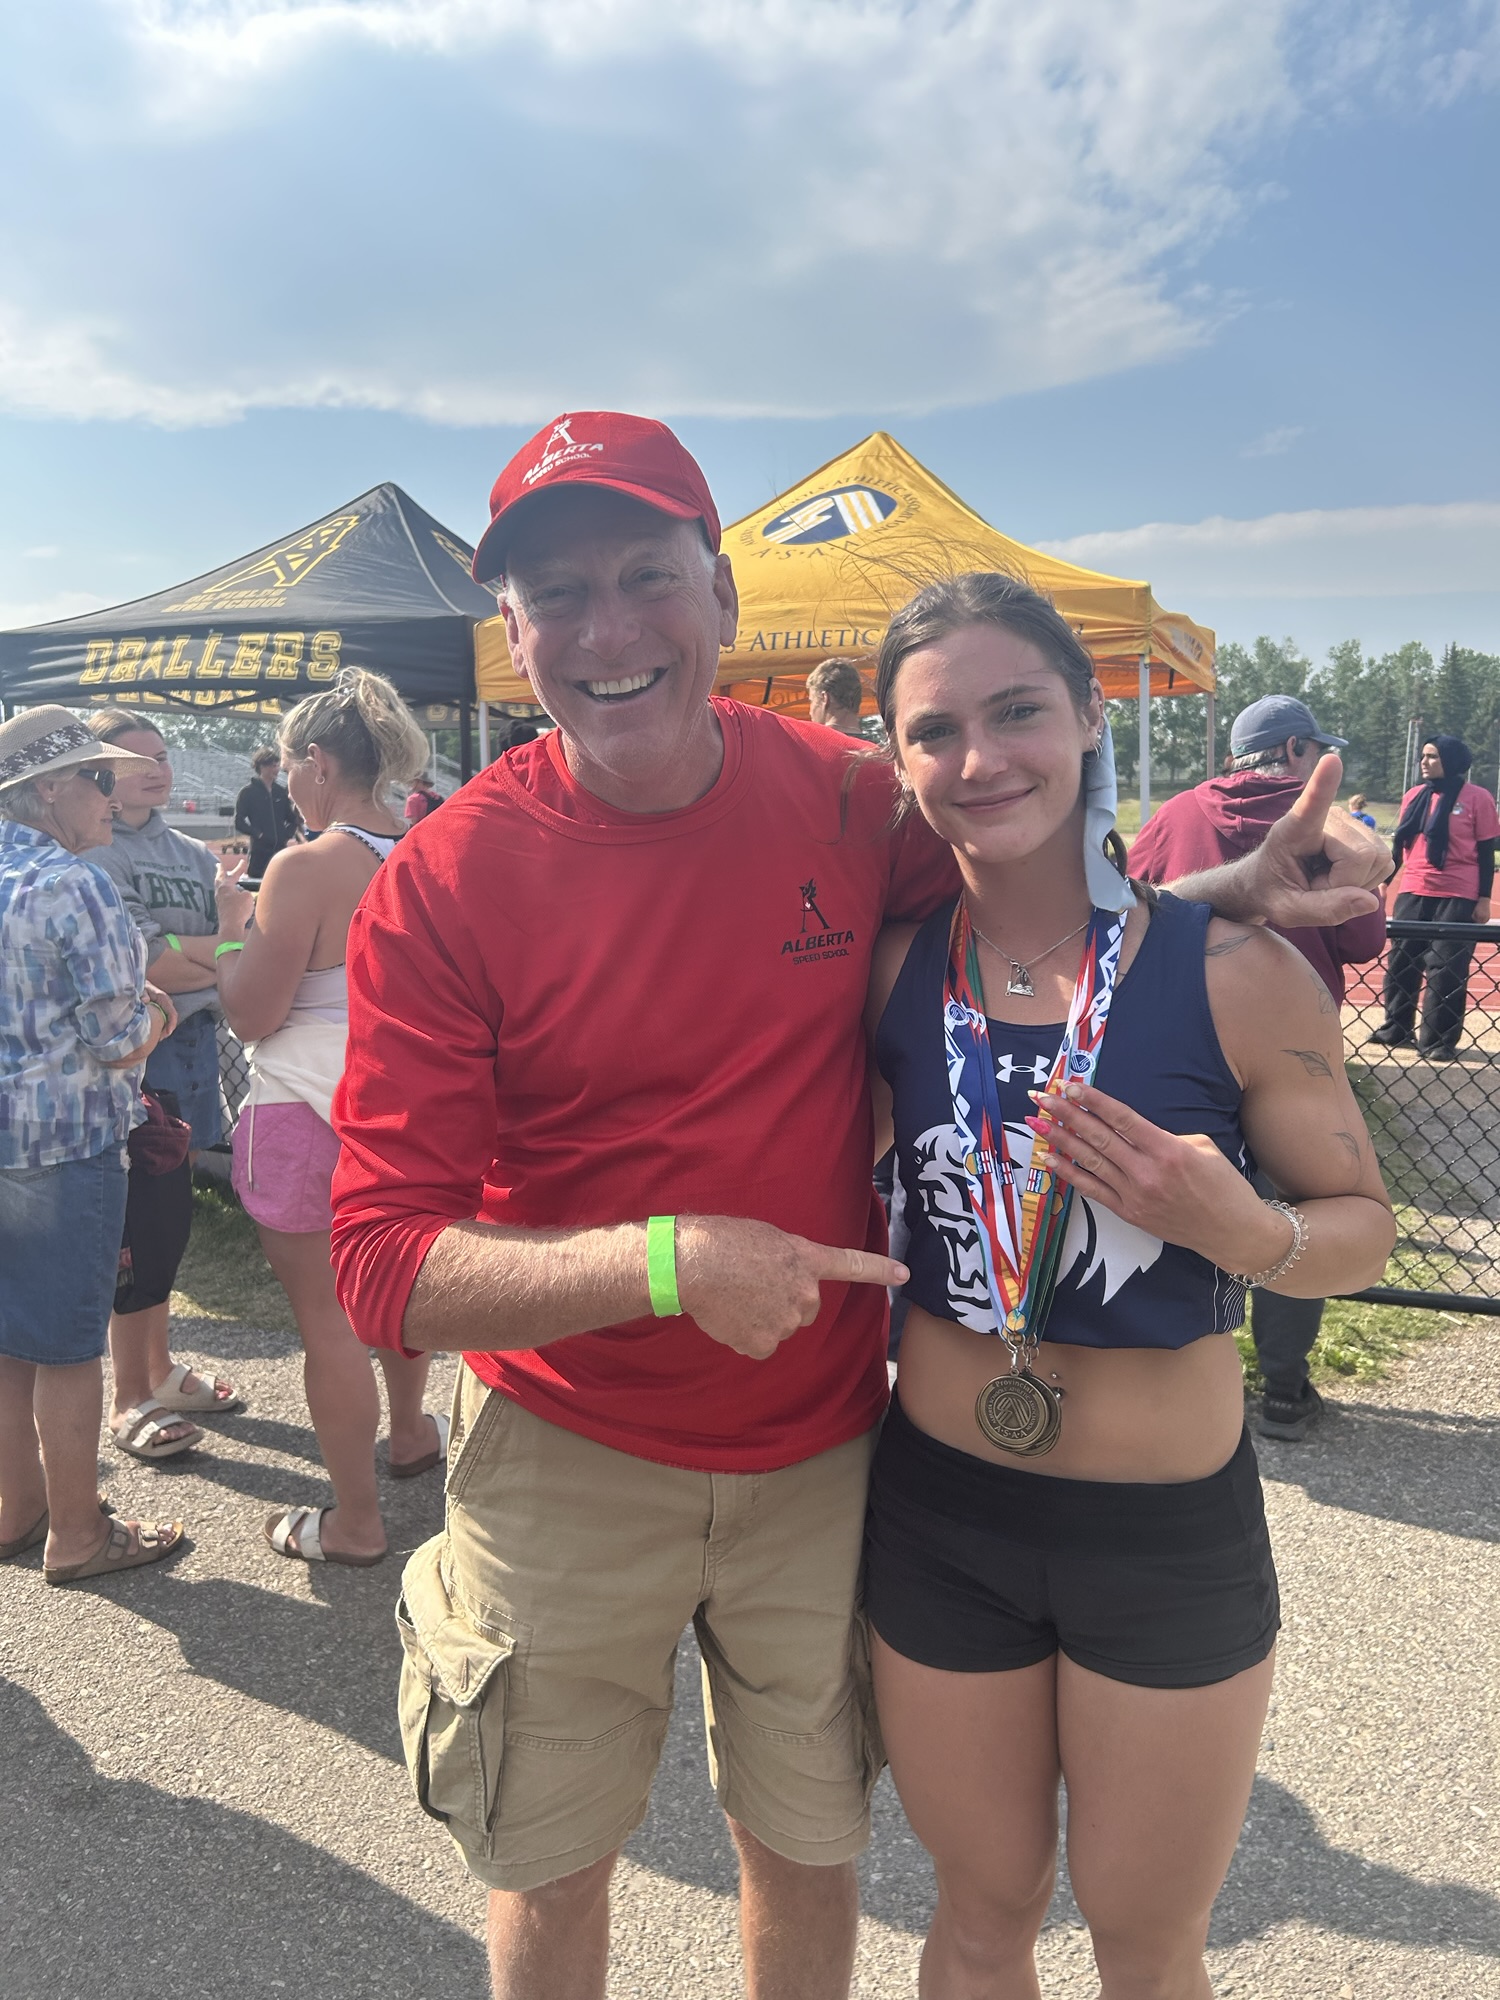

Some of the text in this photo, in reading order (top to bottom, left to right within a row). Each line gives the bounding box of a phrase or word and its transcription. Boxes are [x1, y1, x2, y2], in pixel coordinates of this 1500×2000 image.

[522, 443, 603, 484] ALBERTA
[555, 453, 592, 467] SCHOOL
[211, 596, 288, 610] SCHOOL
[749, 628, 880, 652] ATHLETIC
[781, 930, 855, 955] ALBERTA
[793, 948, 850, 965] SPEED SCHOOL
[995, 1379, 1034, 1394] Provincial
